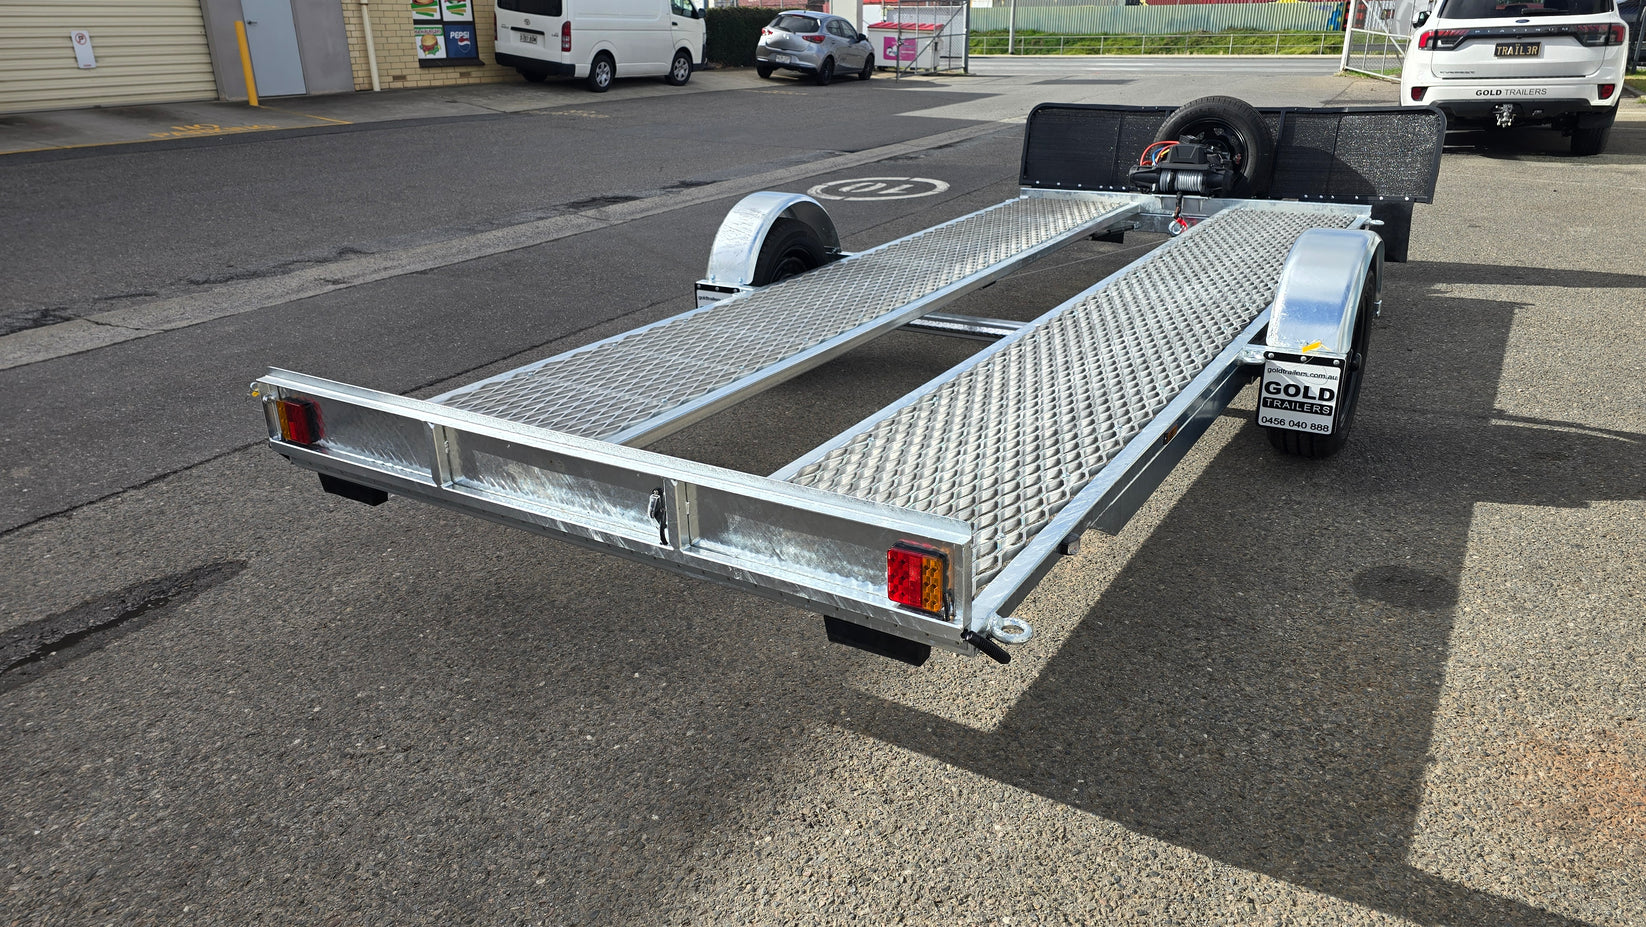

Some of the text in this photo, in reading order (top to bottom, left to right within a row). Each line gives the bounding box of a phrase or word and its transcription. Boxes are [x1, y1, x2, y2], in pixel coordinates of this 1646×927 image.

[450, 31, 470, 39] PEPSI
[1504, 88, 1547, 96] TRAILERS
[1267, 366, 1338, 381] goldtrailers.com.au
[1264, 381, 1335, 401] GOLD
[1265, 398, 1330, 414] TRAILERS
[1261, 416, 1329, 432] 0456 040 888
